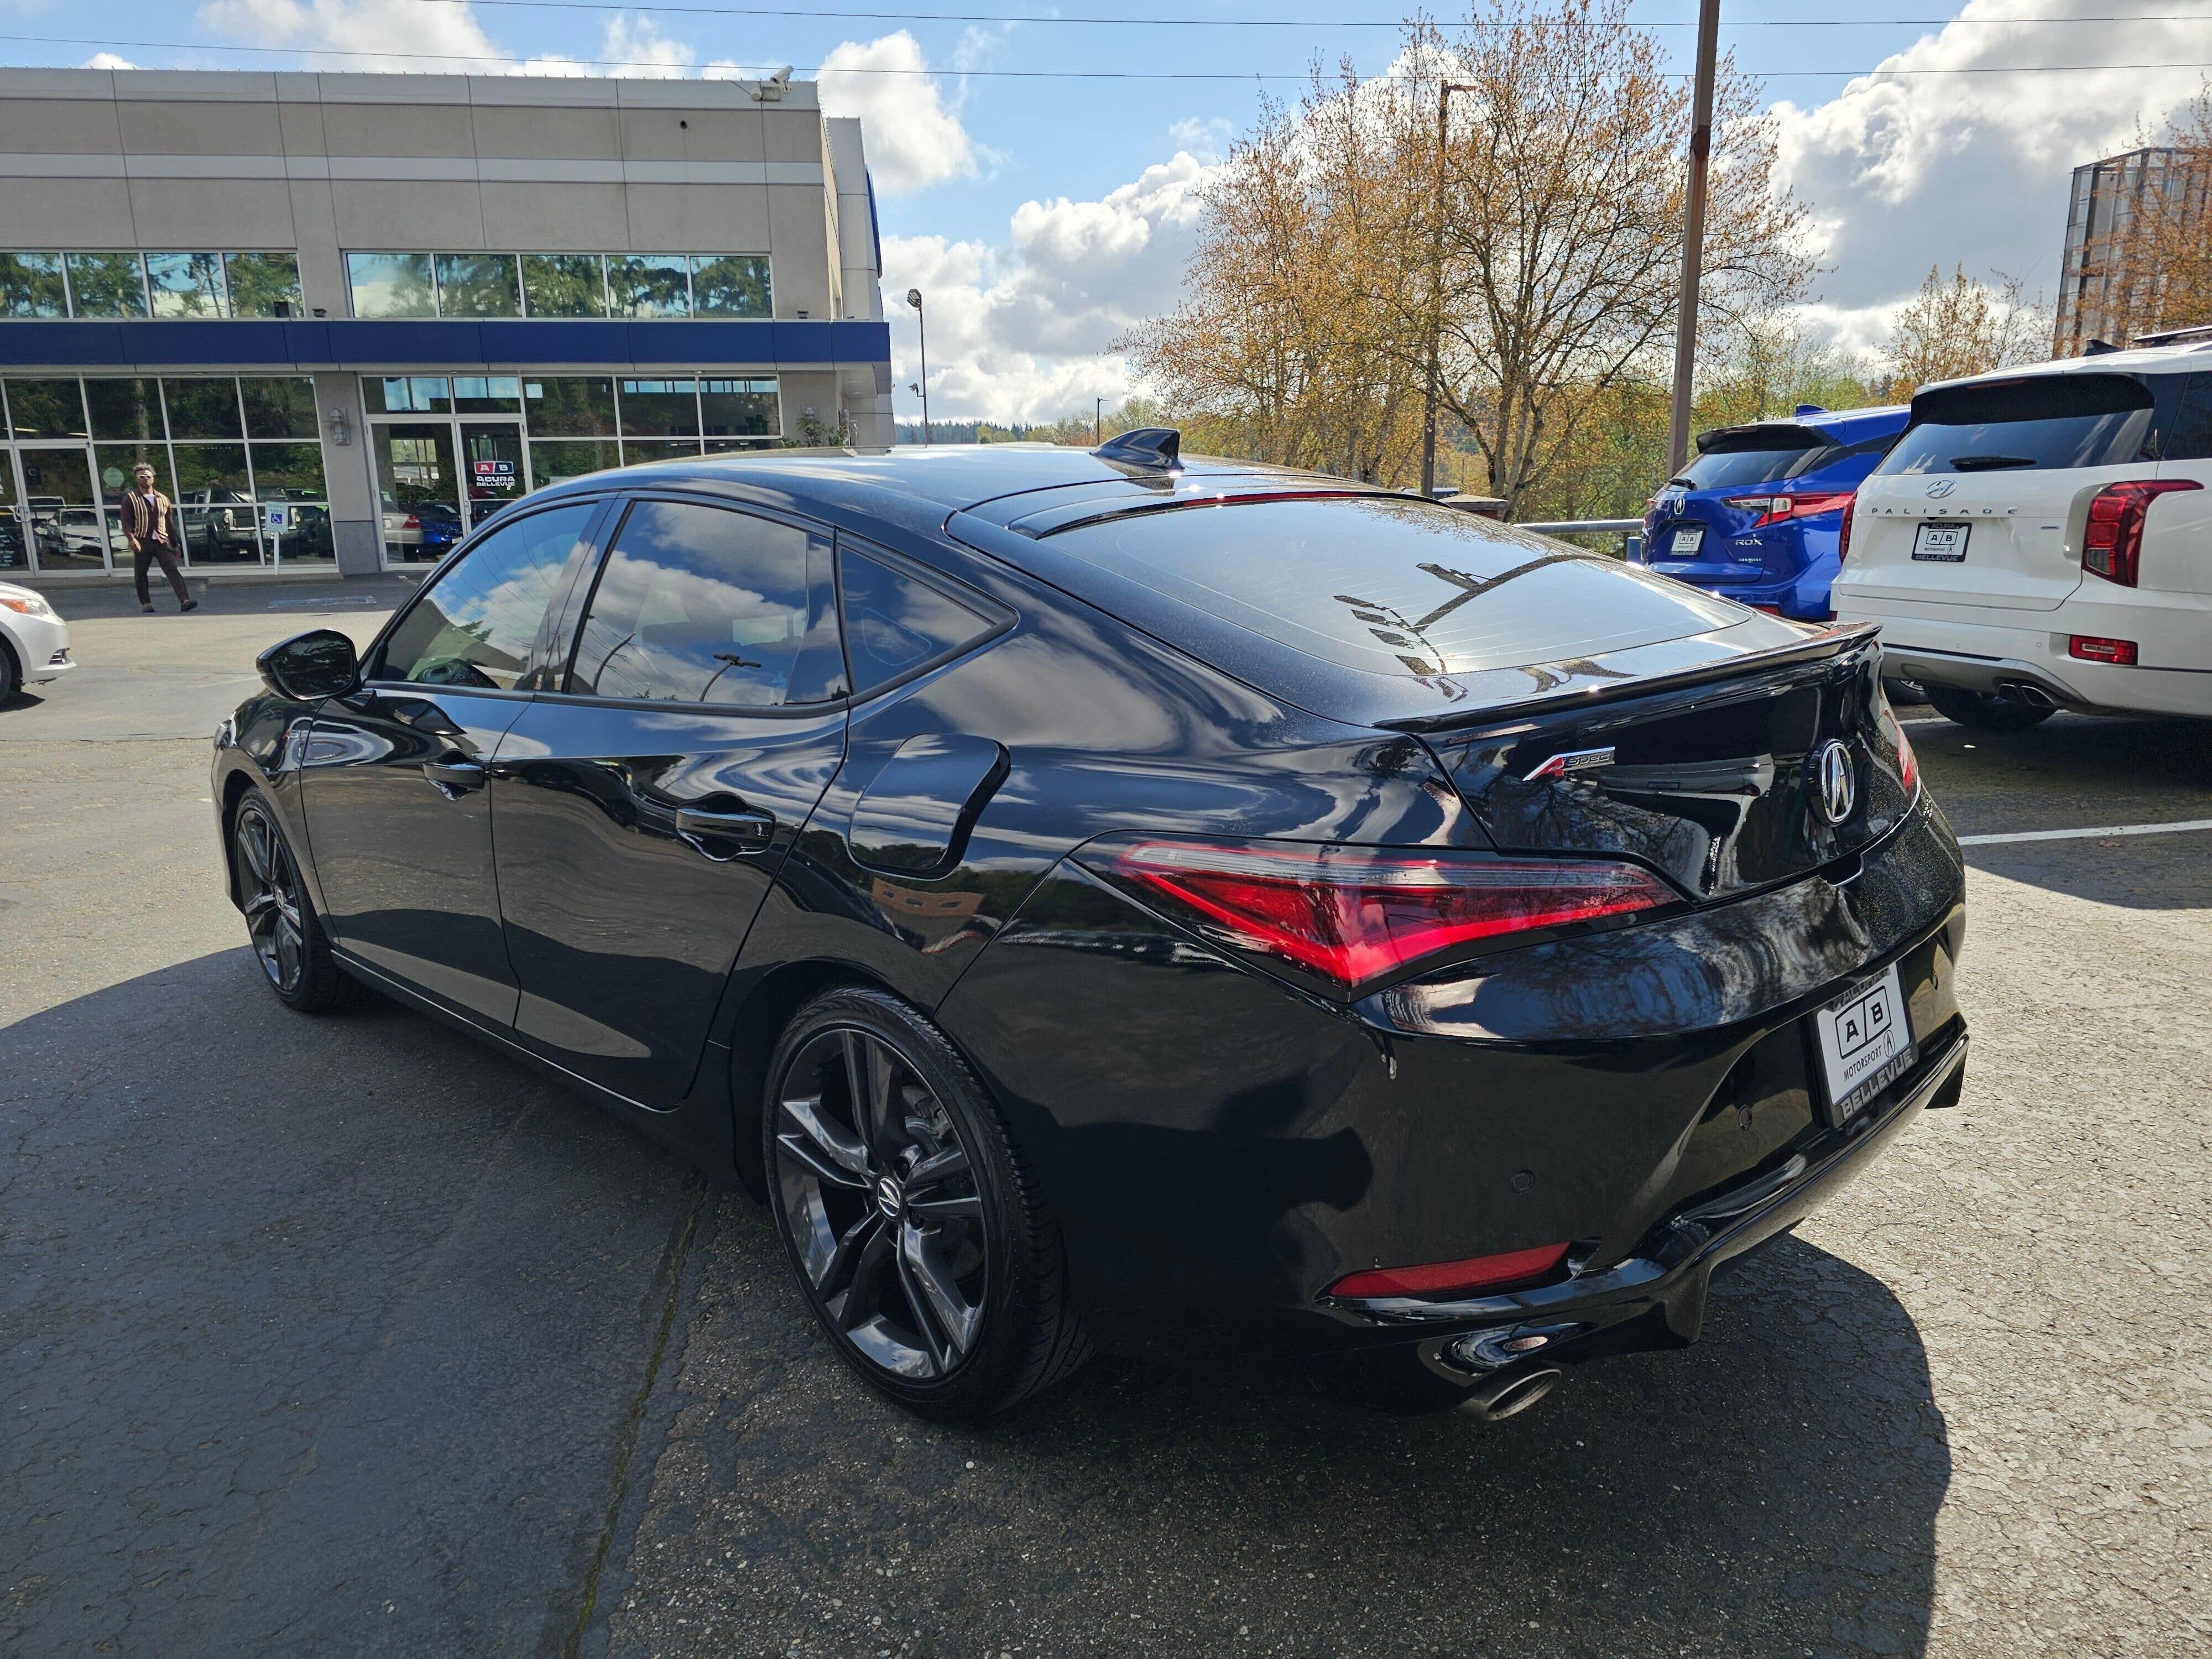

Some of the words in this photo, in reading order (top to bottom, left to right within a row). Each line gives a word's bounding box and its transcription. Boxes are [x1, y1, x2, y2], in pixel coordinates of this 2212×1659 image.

[1735, 534, 1763, 545] RDX
[1845, 1019, 1859, 1042] A
[1871, 1001, 1883, 1025] B
[1844, 1046, 1881, 1082] MOTORSPORT
[1840, 1048, 1913, 1119] BELLEVUE
